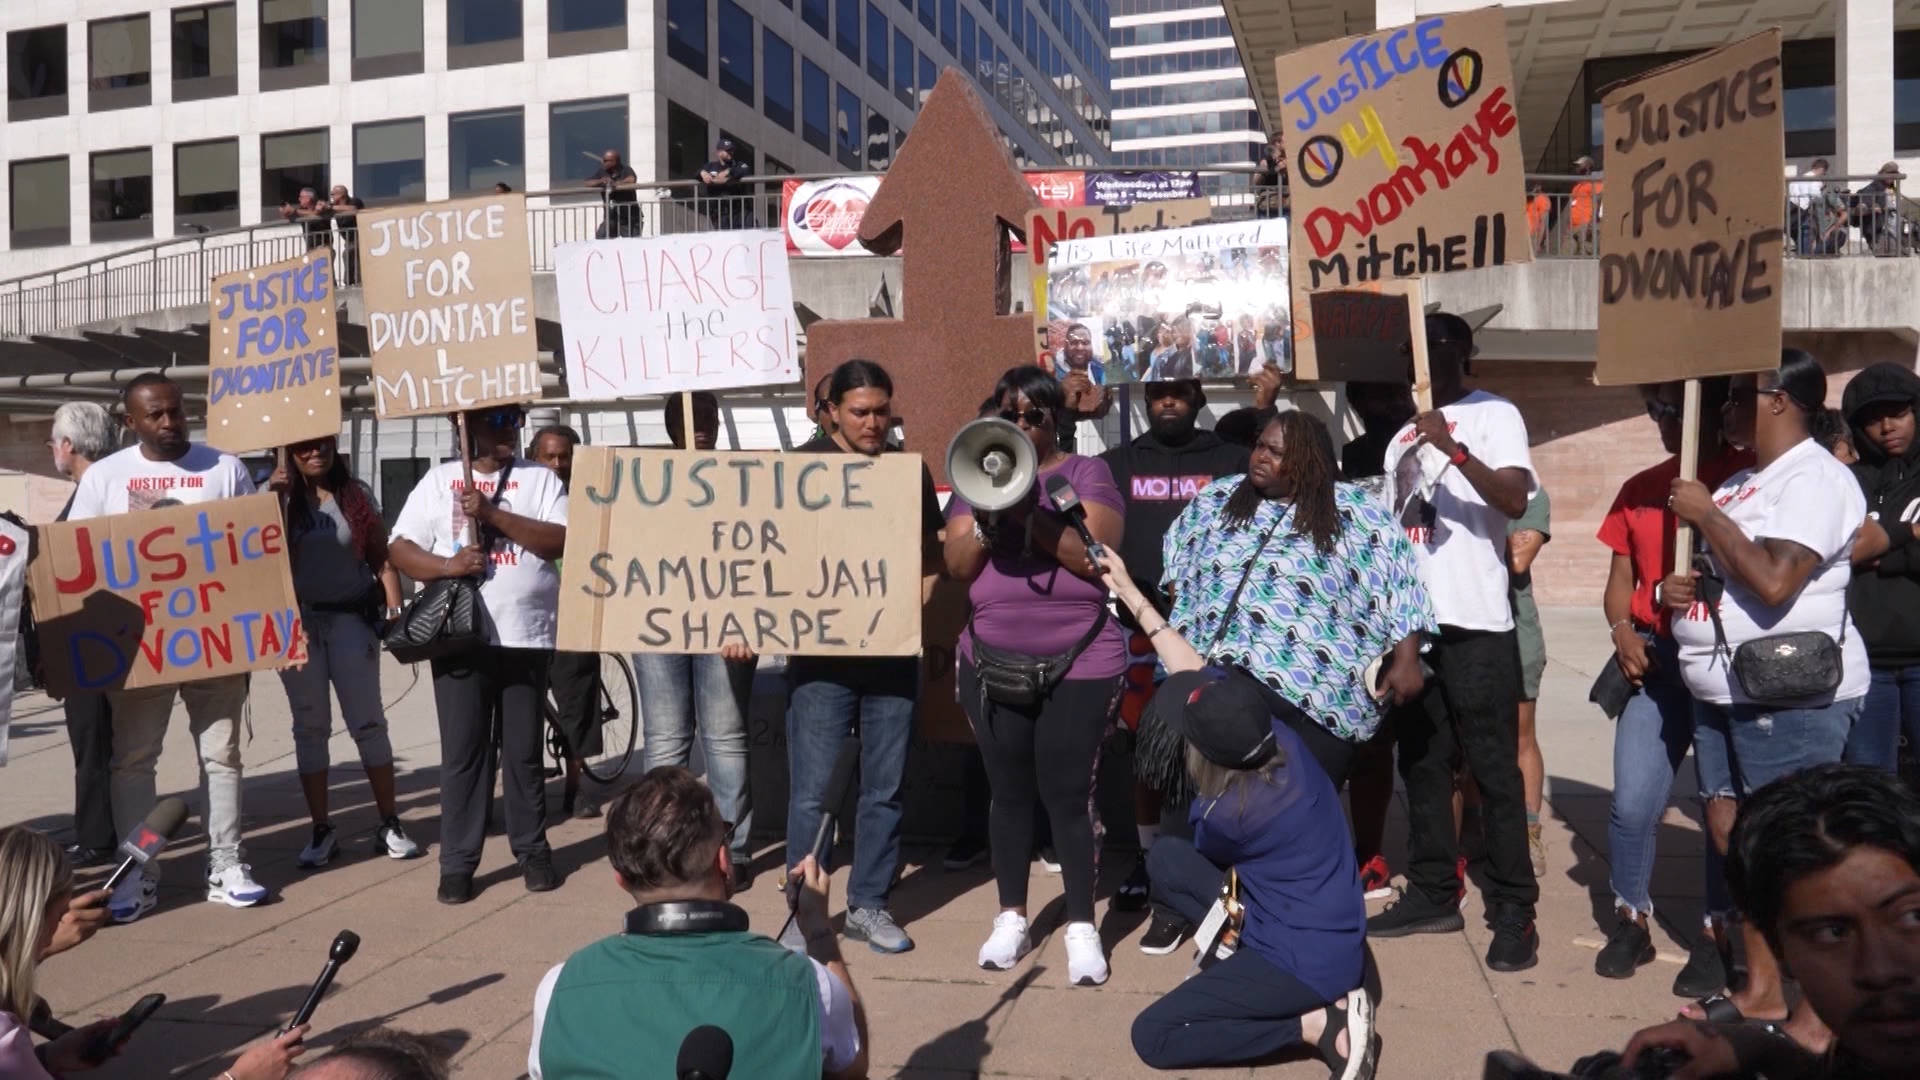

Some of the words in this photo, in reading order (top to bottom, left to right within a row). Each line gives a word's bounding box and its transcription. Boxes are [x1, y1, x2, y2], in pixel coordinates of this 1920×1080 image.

[1340, 104, 1398, 171] 4
[1632, 158, 1717, 238] FOR
[371, 205, 505, 257] JUSTICE
[218, 257, 329, 320] JUSTICE
[405, 251, 475, 299] FOR
[586, 240, 781, 314] CHARGE
[1600, 229, 1785, 310] DVONTAYE
[237, 308, 311, 358] FOR
[371, 297, 528, 351] DVONTAYE
[663, 309, 725, 340] the
[210, 346, 336, 405] DVONTAYE
[437, 349, 464, 376] L
[577, 318, 792, 389] KILLERS!
[376, 361, 542, 415] MITCHELL
[127, 477, 176, 491] JUSTICE
[180, 477, 204, 488] FOR
[450, 480, 497, 492] JUTICE
[501, 481, 519, 491] OR
[586, 457, 874, 510] JUSTICE
[712, 520, 787, 554] FOR
[581, 551, 790, 601] SAMUEL
[806, 556, 888, 600] JAH
